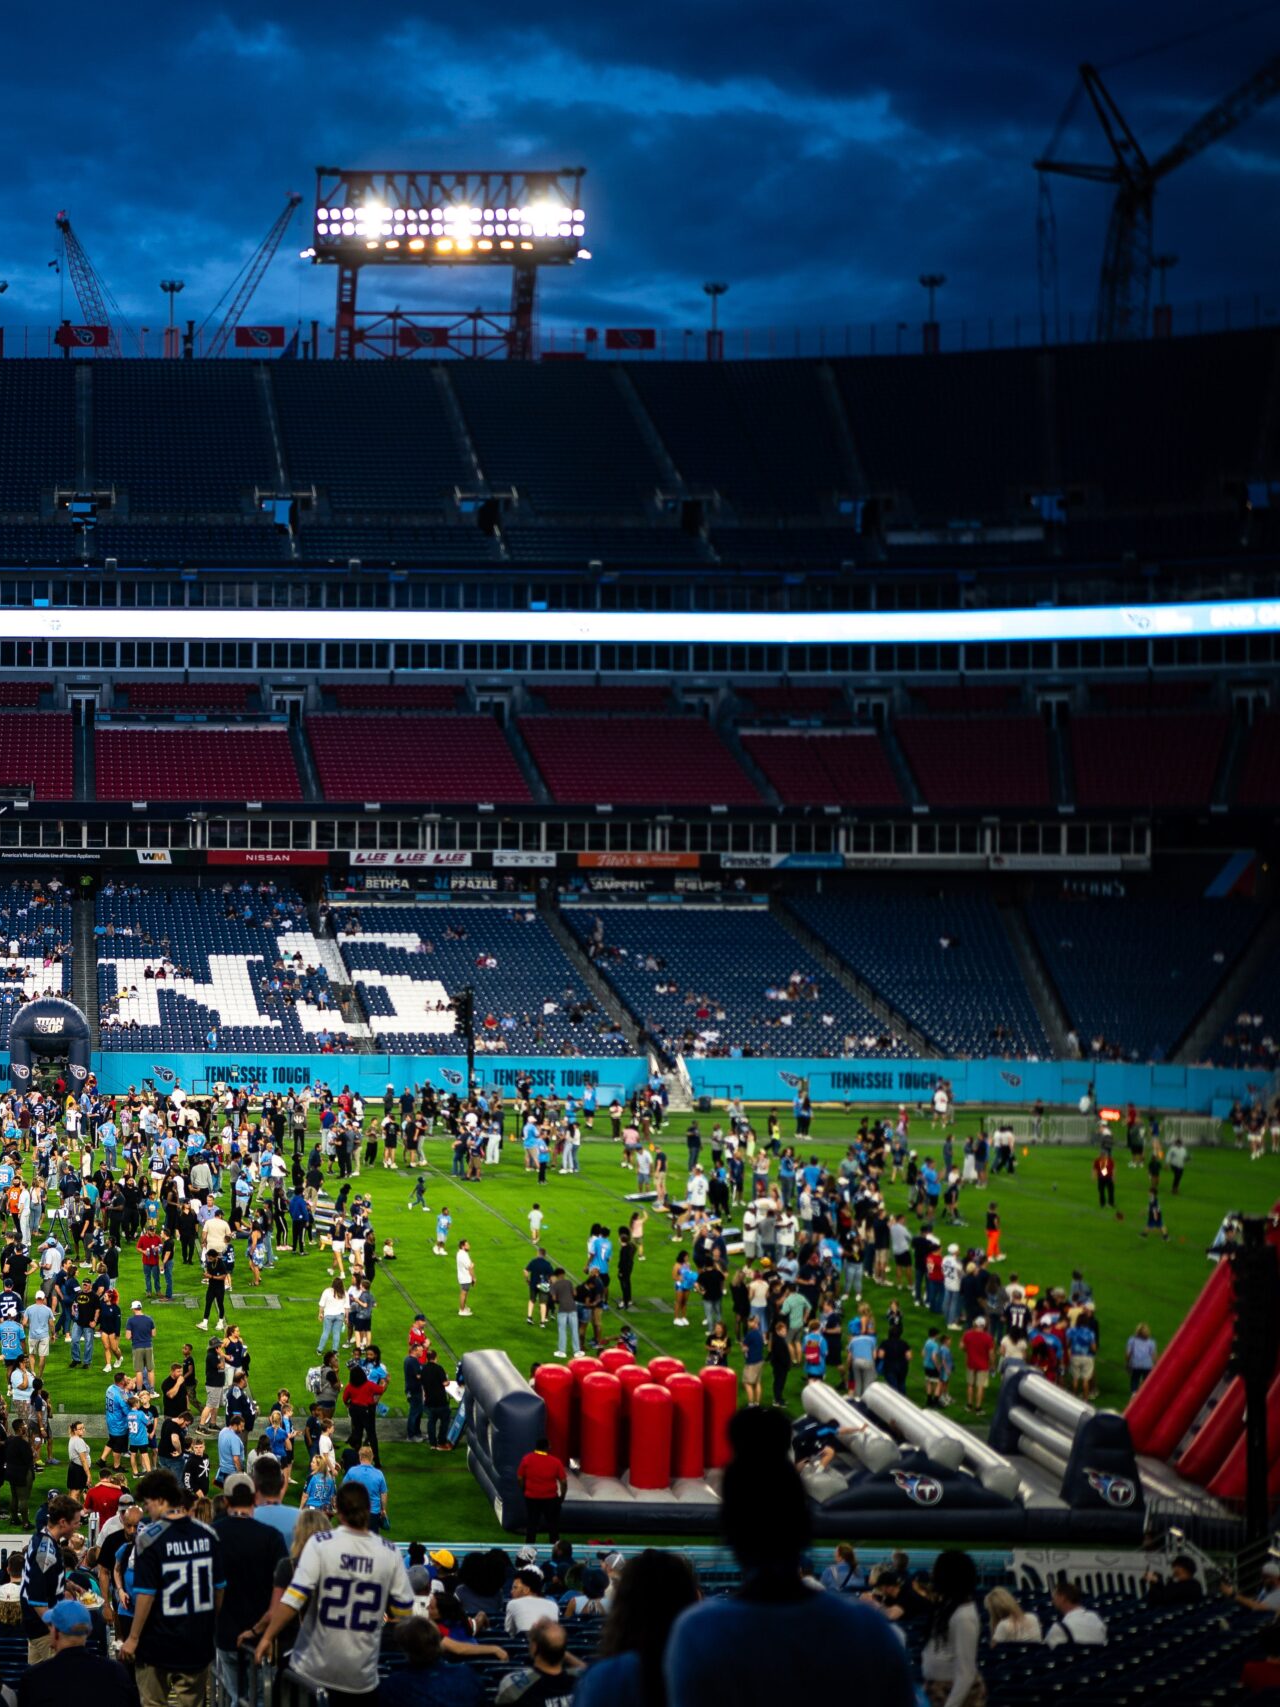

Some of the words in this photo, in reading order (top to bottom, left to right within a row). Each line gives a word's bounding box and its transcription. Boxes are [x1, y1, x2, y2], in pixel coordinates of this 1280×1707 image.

[142, 853, 166, 861] WM
[367, 853, 388, 861] LEE
[405, 853, 426, 861] LEE
[445, 853, 466, 861] LEE
[36, 1016, 65, 1026] TITAN
[47, 1024, 63, 1034] UP
[205, 1066, 267, 1083] TENNESSEE
[272, 1066, 311, 1084] TOUGH
[831, 1071, 893, 1089] TENNESSEE
[899, 1072, 938, 1090] TOUGH
[166, 1538, 210, 1557] POLLARD
[340, 1554, 373, 1574] SMITH
[162, 1557, 214, 1616] 20
[320, 1577, 382, 1632] 22
